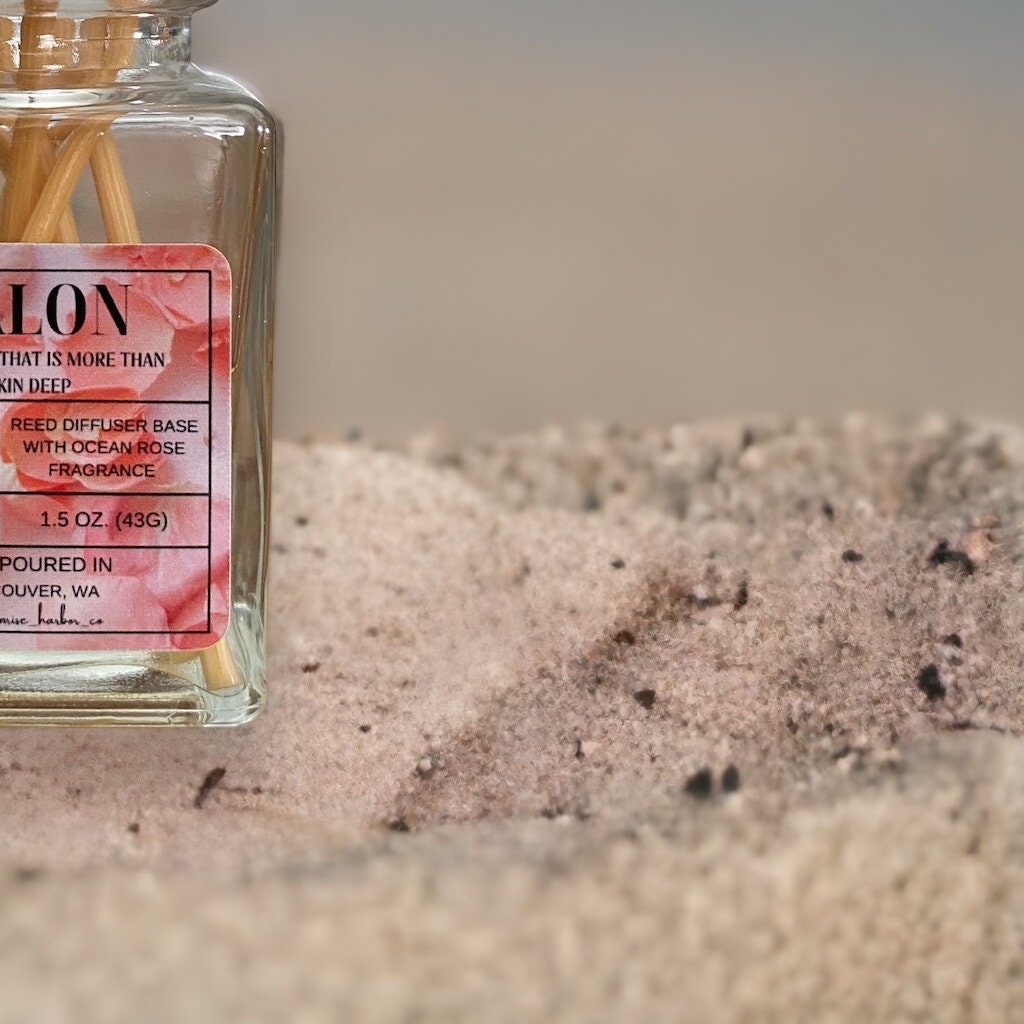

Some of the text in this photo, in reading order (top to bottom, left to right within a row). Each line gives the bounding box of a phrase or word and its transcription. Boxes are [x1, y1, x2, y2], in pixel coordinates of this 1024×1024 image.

[47, 351, 61, 367] IS
[67, 351, 115, 367] MORE
[121, 351, 165, 368] THAN
[29, 377, 71, 394] DEEP
[11, 418, 199, 433] REED DIFFUSER BASE
[23, 440, 186, 456] WITH OCEAN ROSE
[48, 462, 155, 478] FRAGRANCE
[41, 511, 168, 532] 1.5 OZ. (43G)
[0, 556, 86, 572] POURED
[93, 557, 112, 572] IN
[71, 585, 100, 598] WA
